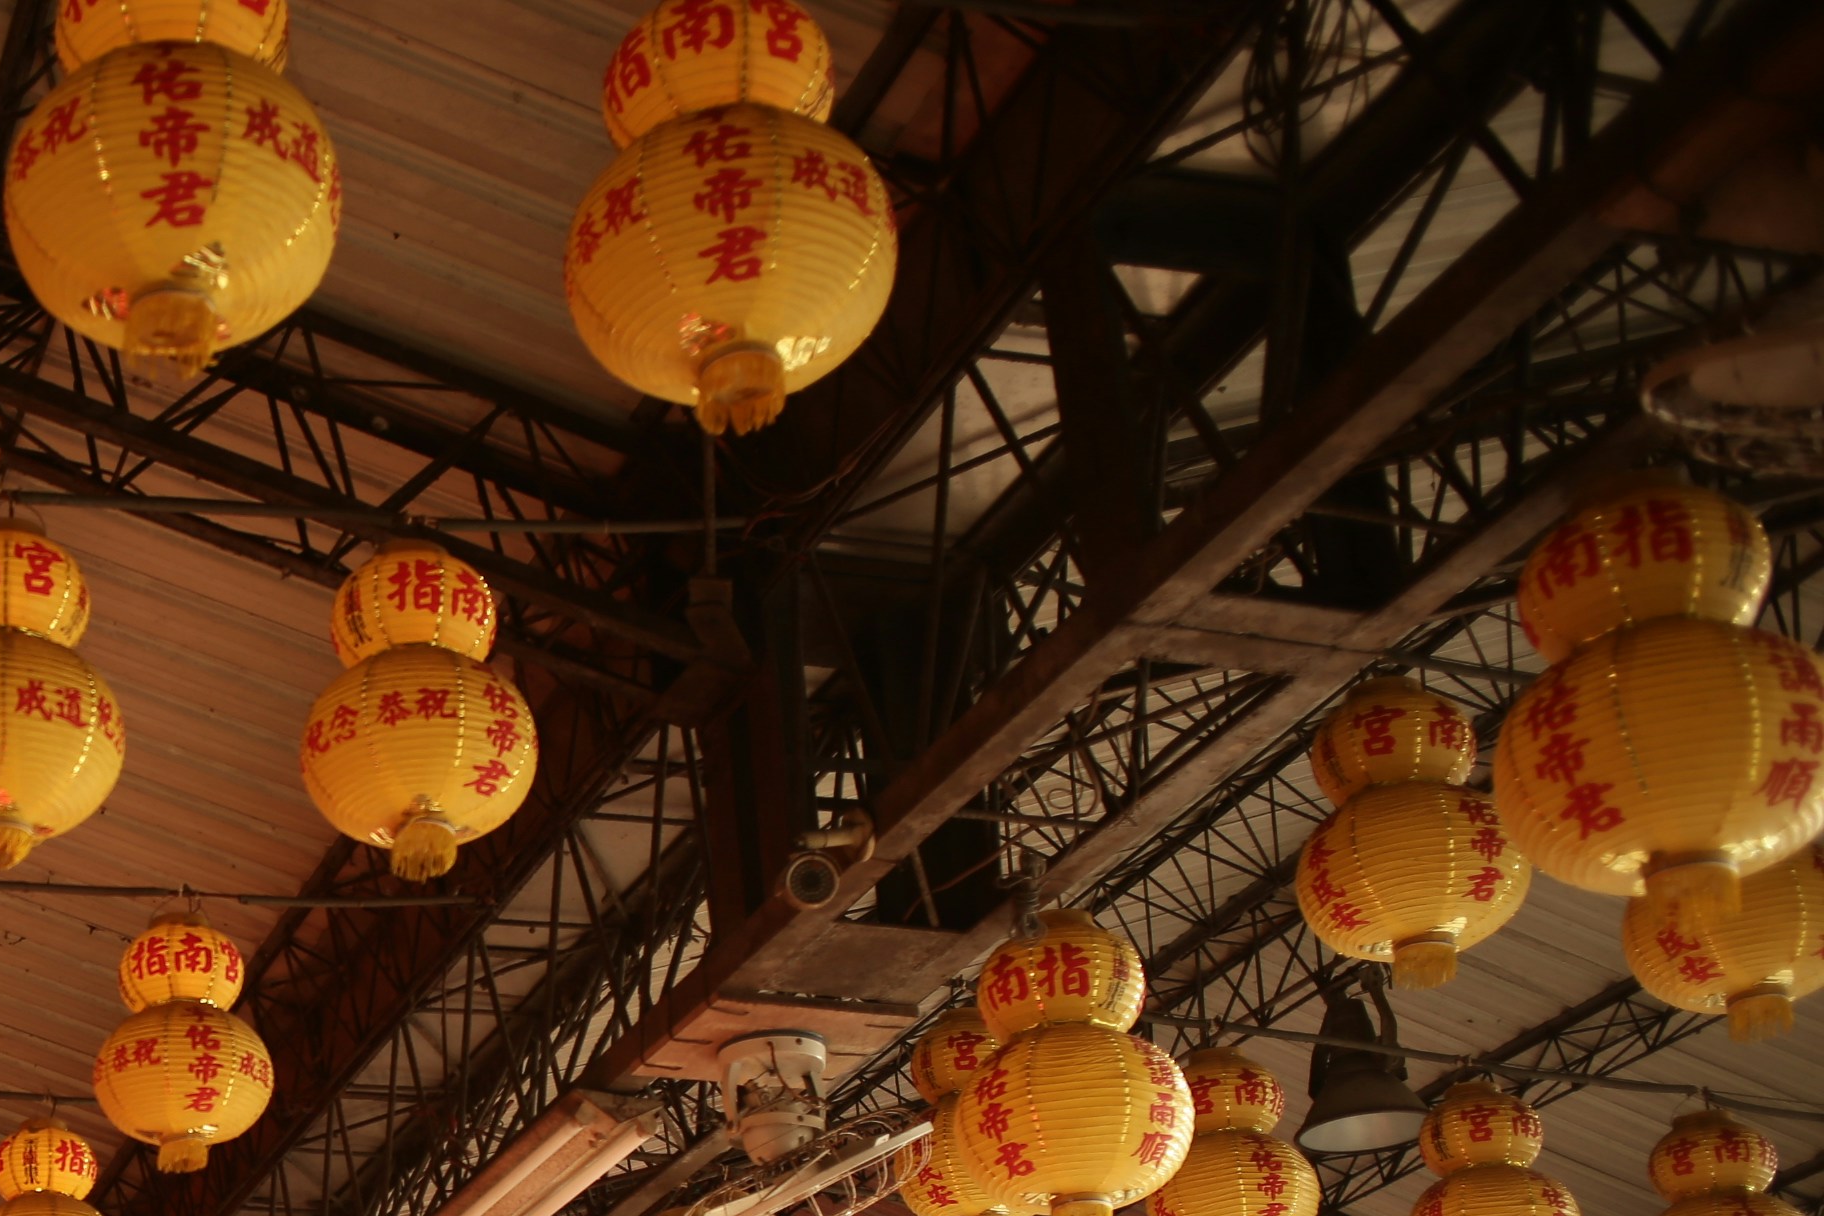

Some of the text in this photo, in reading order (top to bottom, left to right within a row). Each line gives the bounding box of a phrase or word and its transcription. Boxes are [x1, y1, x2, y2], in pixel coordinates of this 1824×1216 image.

[605, 0, 809, 114] 指南宮
[378, 688, 458, 727] 恭祝
